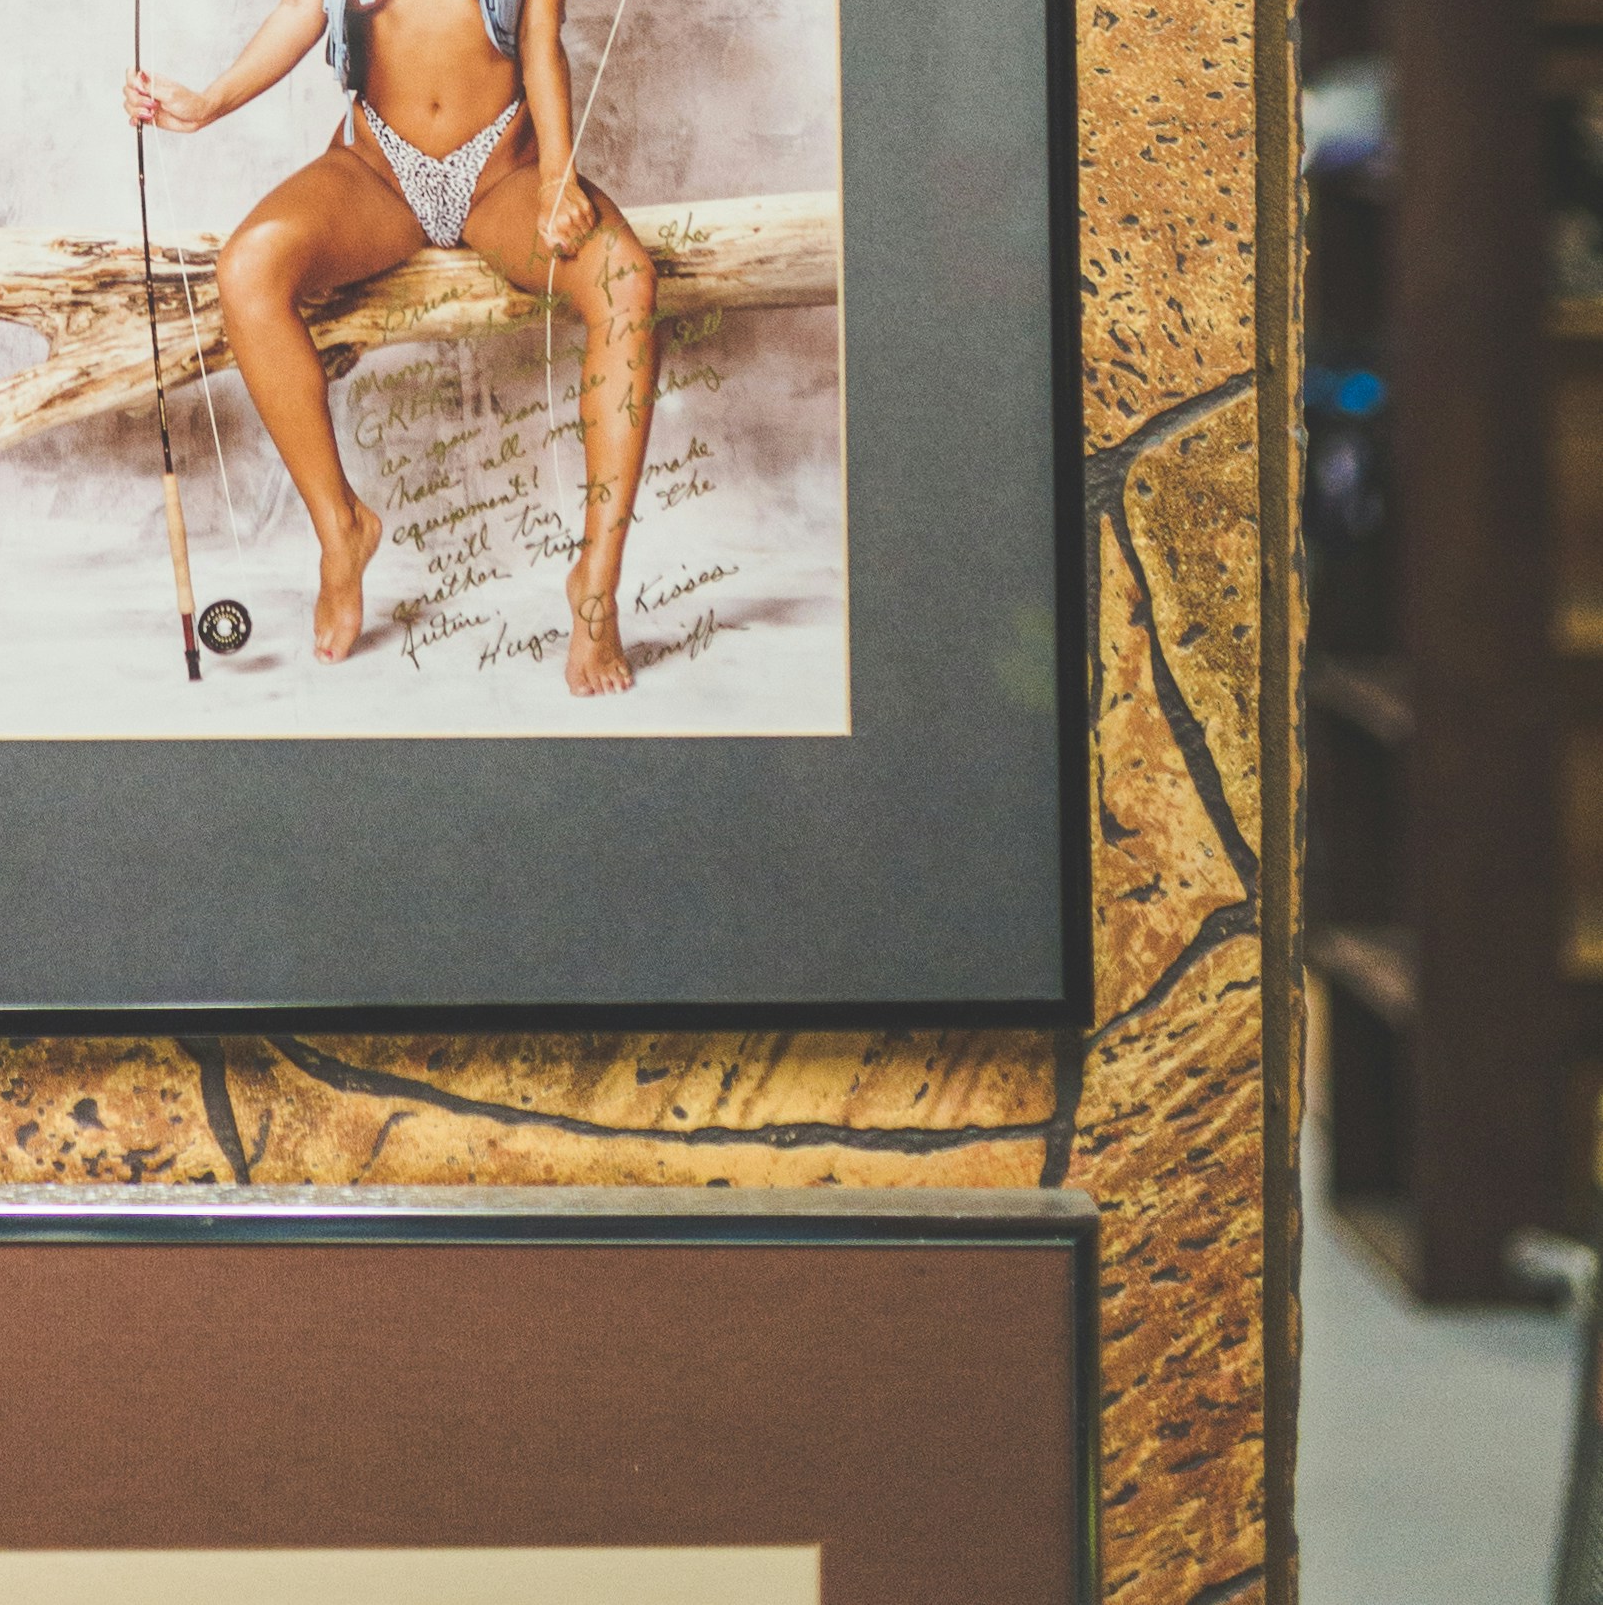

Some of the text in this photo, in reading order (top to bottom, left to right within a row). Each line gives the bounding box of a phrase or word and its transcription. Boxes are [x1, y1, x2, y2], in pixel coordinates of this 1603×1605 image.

[482, 432, 527, 472] all
[577, 473, 619, 511] to
[644, 436, 715, 485] make
